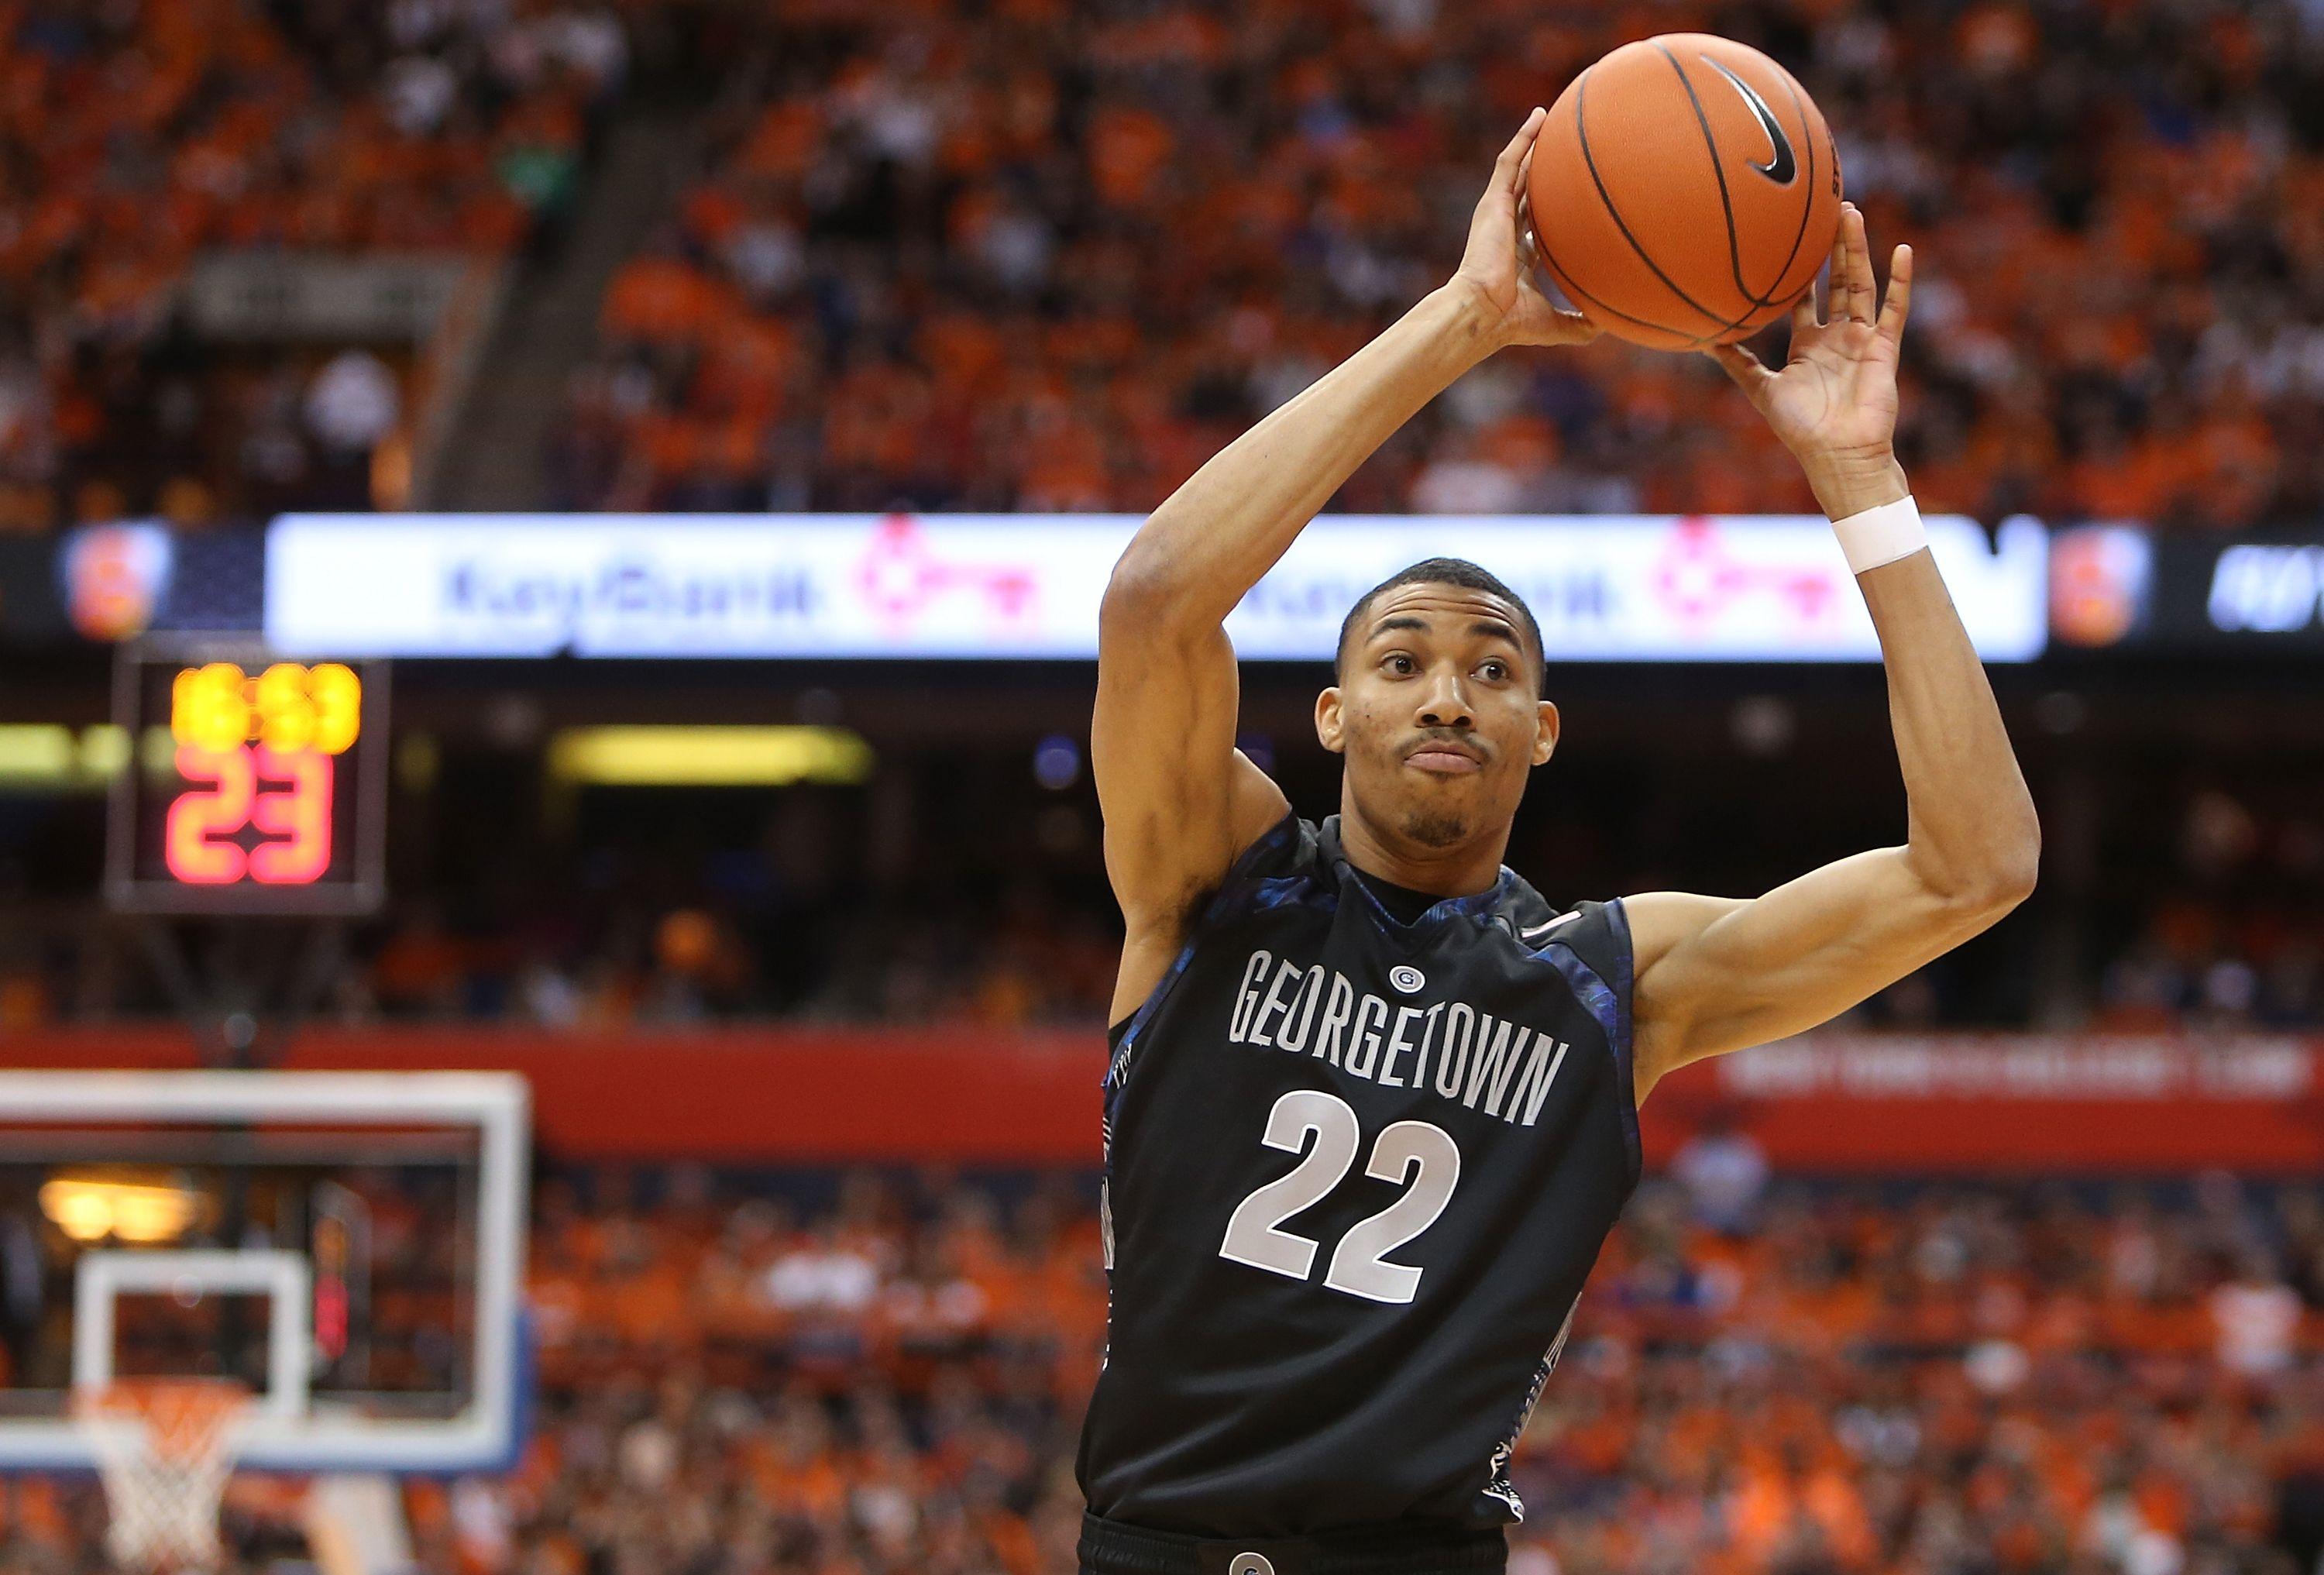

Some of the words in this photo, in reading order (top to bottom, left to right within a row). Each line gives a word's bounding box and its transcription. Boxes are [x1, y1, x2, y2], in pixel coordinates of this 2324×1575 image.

[166, 744, 334, 885] 23
[1229, 950, 1569, 1126] GEORGETOWN
[1219, 1089, 1461, 1304] 22
